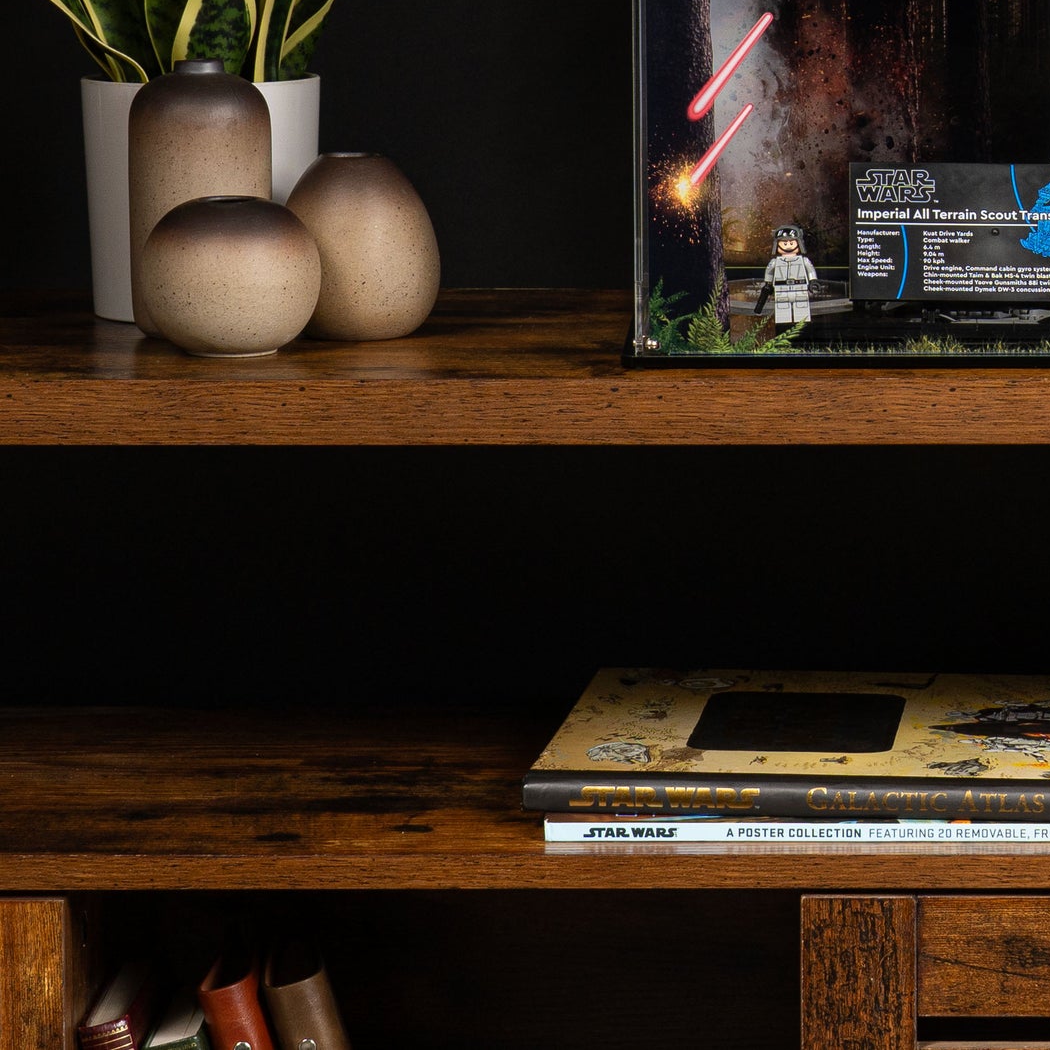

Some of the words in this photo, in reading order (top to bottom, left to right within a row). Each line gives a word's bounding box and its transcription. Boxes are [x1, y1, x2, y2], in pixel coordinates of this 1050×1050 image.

[856, 169, 935, 186] STAR
[858, 208, 910, 220] Imperial
[913, 208, 930, 220] All
[932, 208, 977, 220] Terrain
[980, 210, 1018, 220] Scout
[568, 786, 662, 808] STAR
[662, 786, 760, 810] WARS
[806, 786, 947, 812] GALACTIC
[957, 789, 1046, 814] ATLAS
[583, 828, 630, 838] STAR
[630, 828, 677, 838] WARS
[726, 828, 734, 838] A
[738, 828, 785, 838] POSTER
[788, 828, 862, 838] COLLECTION
[868, 828, 934, 839] FEATURING
[938, 828, 952, 839] 20
[956, 828, 1030, 841] REMOVABLE,
